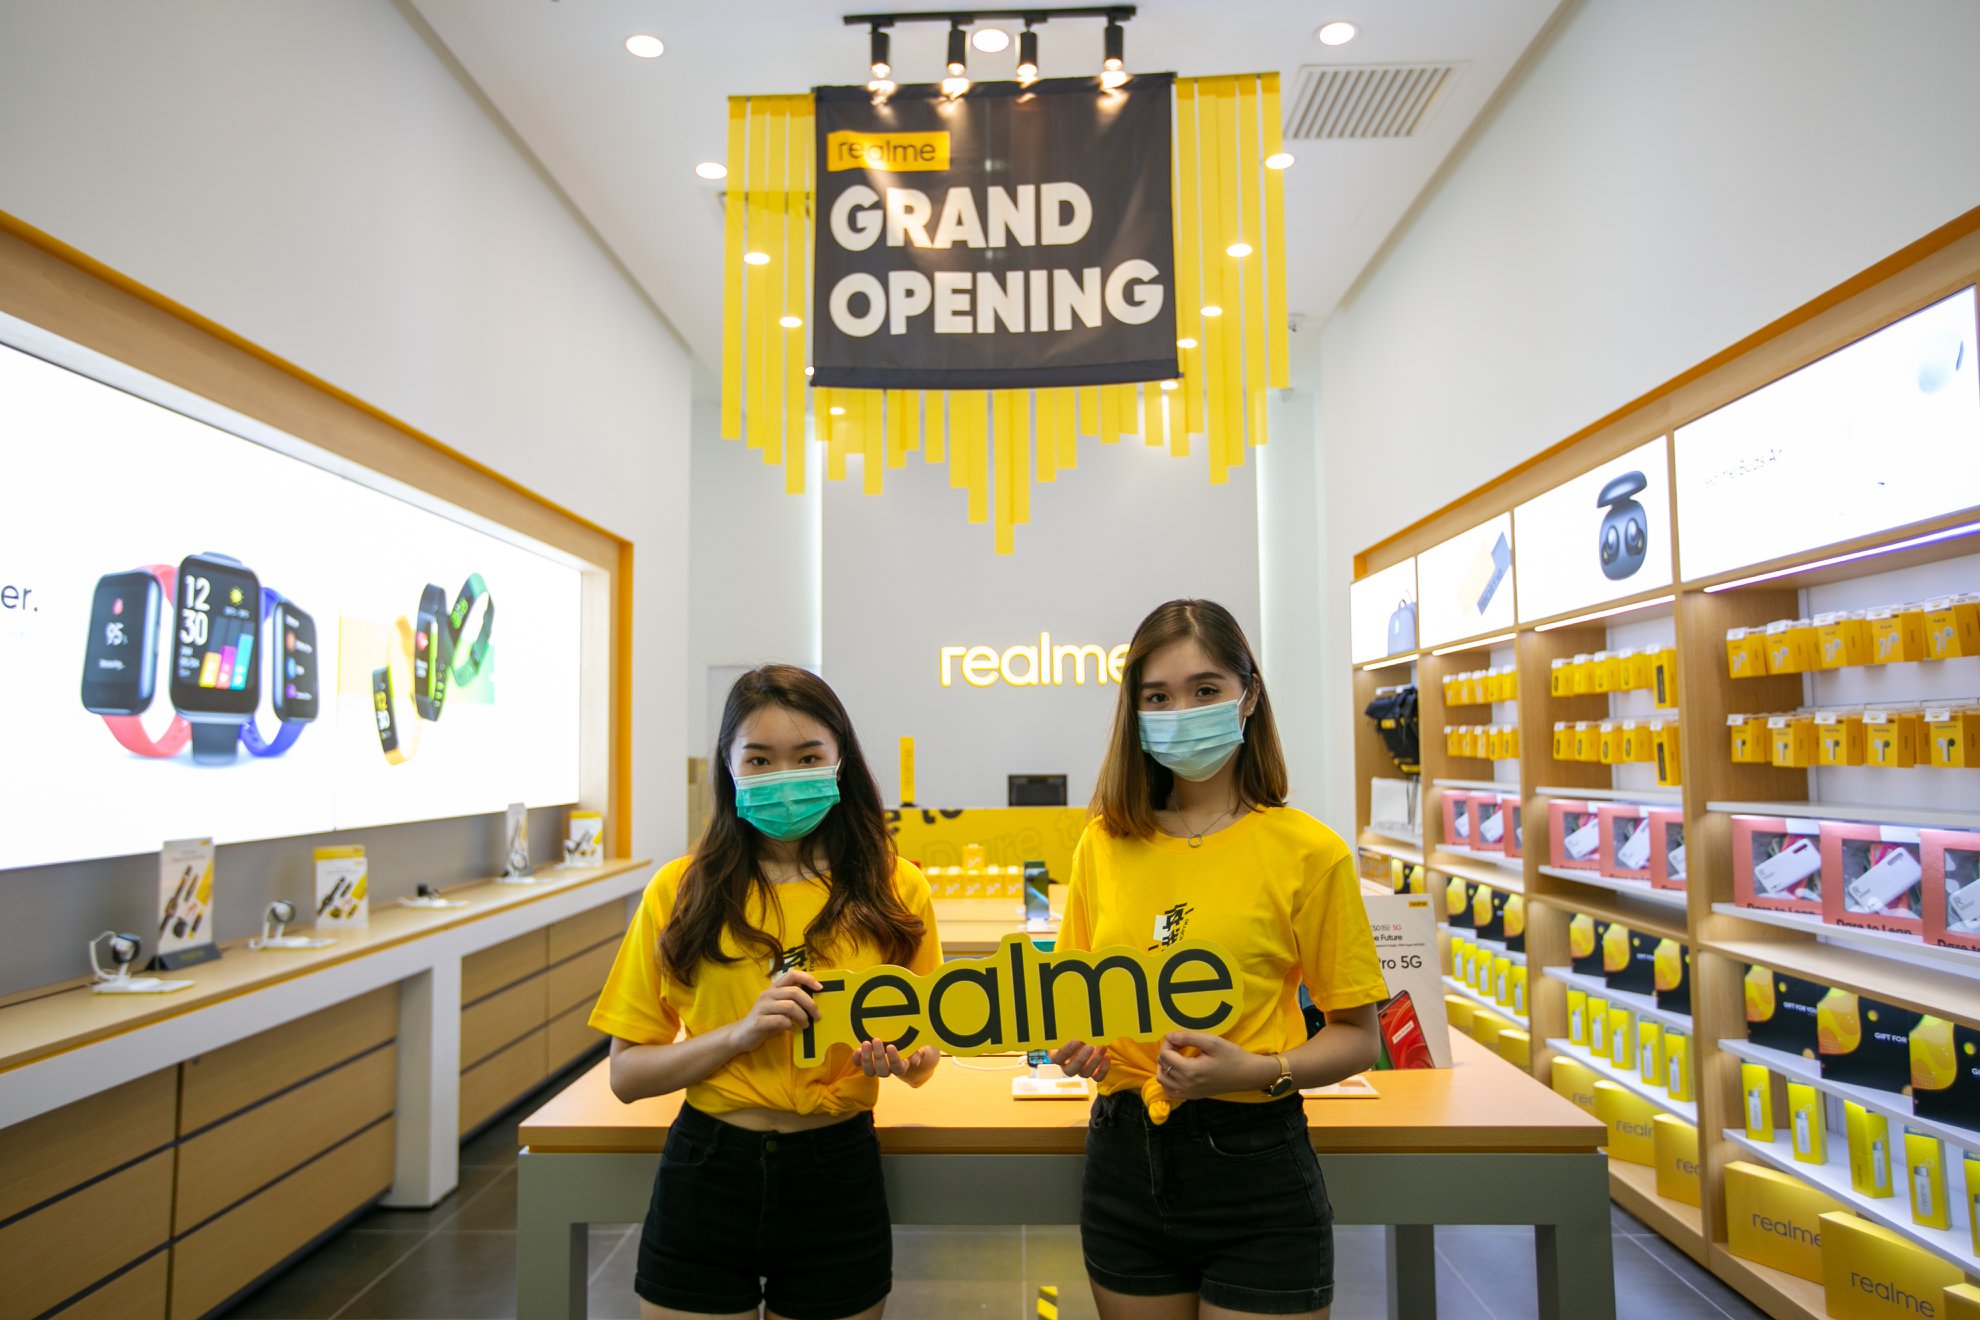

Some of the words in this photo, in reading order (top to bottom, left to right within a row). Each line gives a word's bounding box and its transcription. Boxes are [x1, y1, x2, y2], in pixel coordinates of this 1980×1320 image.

[838, 140, 935, 162] realme
[830, 181, 1093, 251] GRAND
[829, 259, 1164, 337] OPENING
[184, 574, 211, 611] 12
[178, 609, 209, 646] 30
[1400, 955, 1422, 969] 5G
[802, 942, 1233, 1059] realme
[1874, 1032, 1891, 1042] GIFT
[1892, 1034, 1907, 1043] FOR
[1751, 1213, 1822, 1248] realme
[1850, 1272, 1935, 1318] realme
